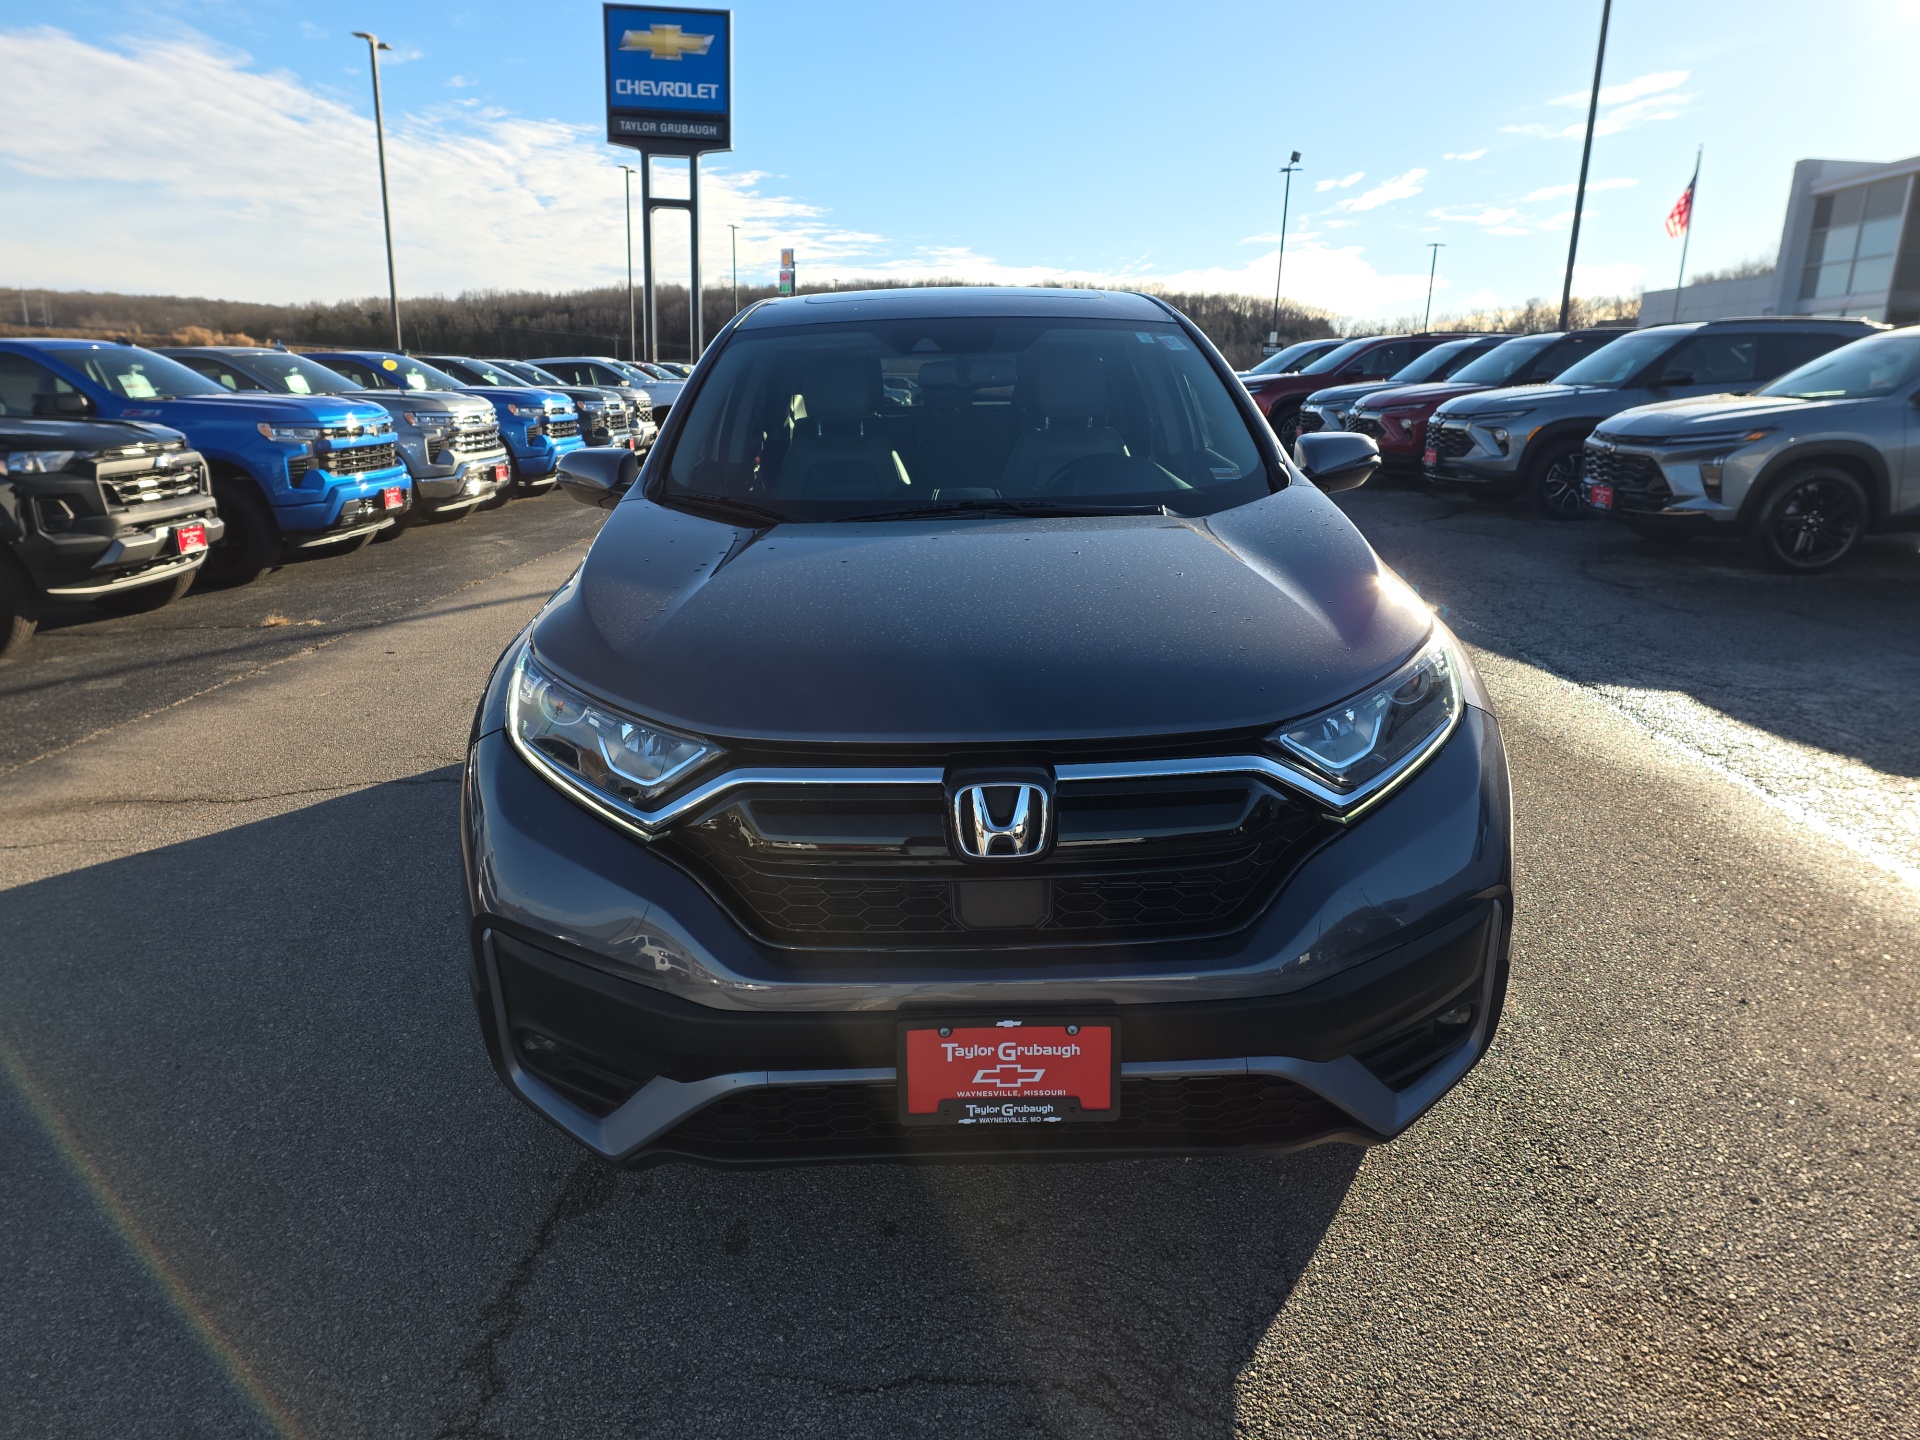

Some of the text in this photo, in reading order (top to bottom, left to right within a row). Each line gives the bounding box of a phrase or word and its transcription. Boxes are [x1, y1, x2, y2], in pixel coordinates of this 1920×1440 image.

[615, 79, 719, 99] CHEVROLET
[620, 120, 717, 135] TAYLOR GRUBAUGH
[941, 1042, 1080, 1062] Taylor Grubaugh
[957, 1089, 1066, 1098] WAYNESVILLE, MISSOURI
[966, 1103, 1054, 1117] Taylor Grubaugh
[978, 1116, 1029, 1124] WAYNESVILLE,
